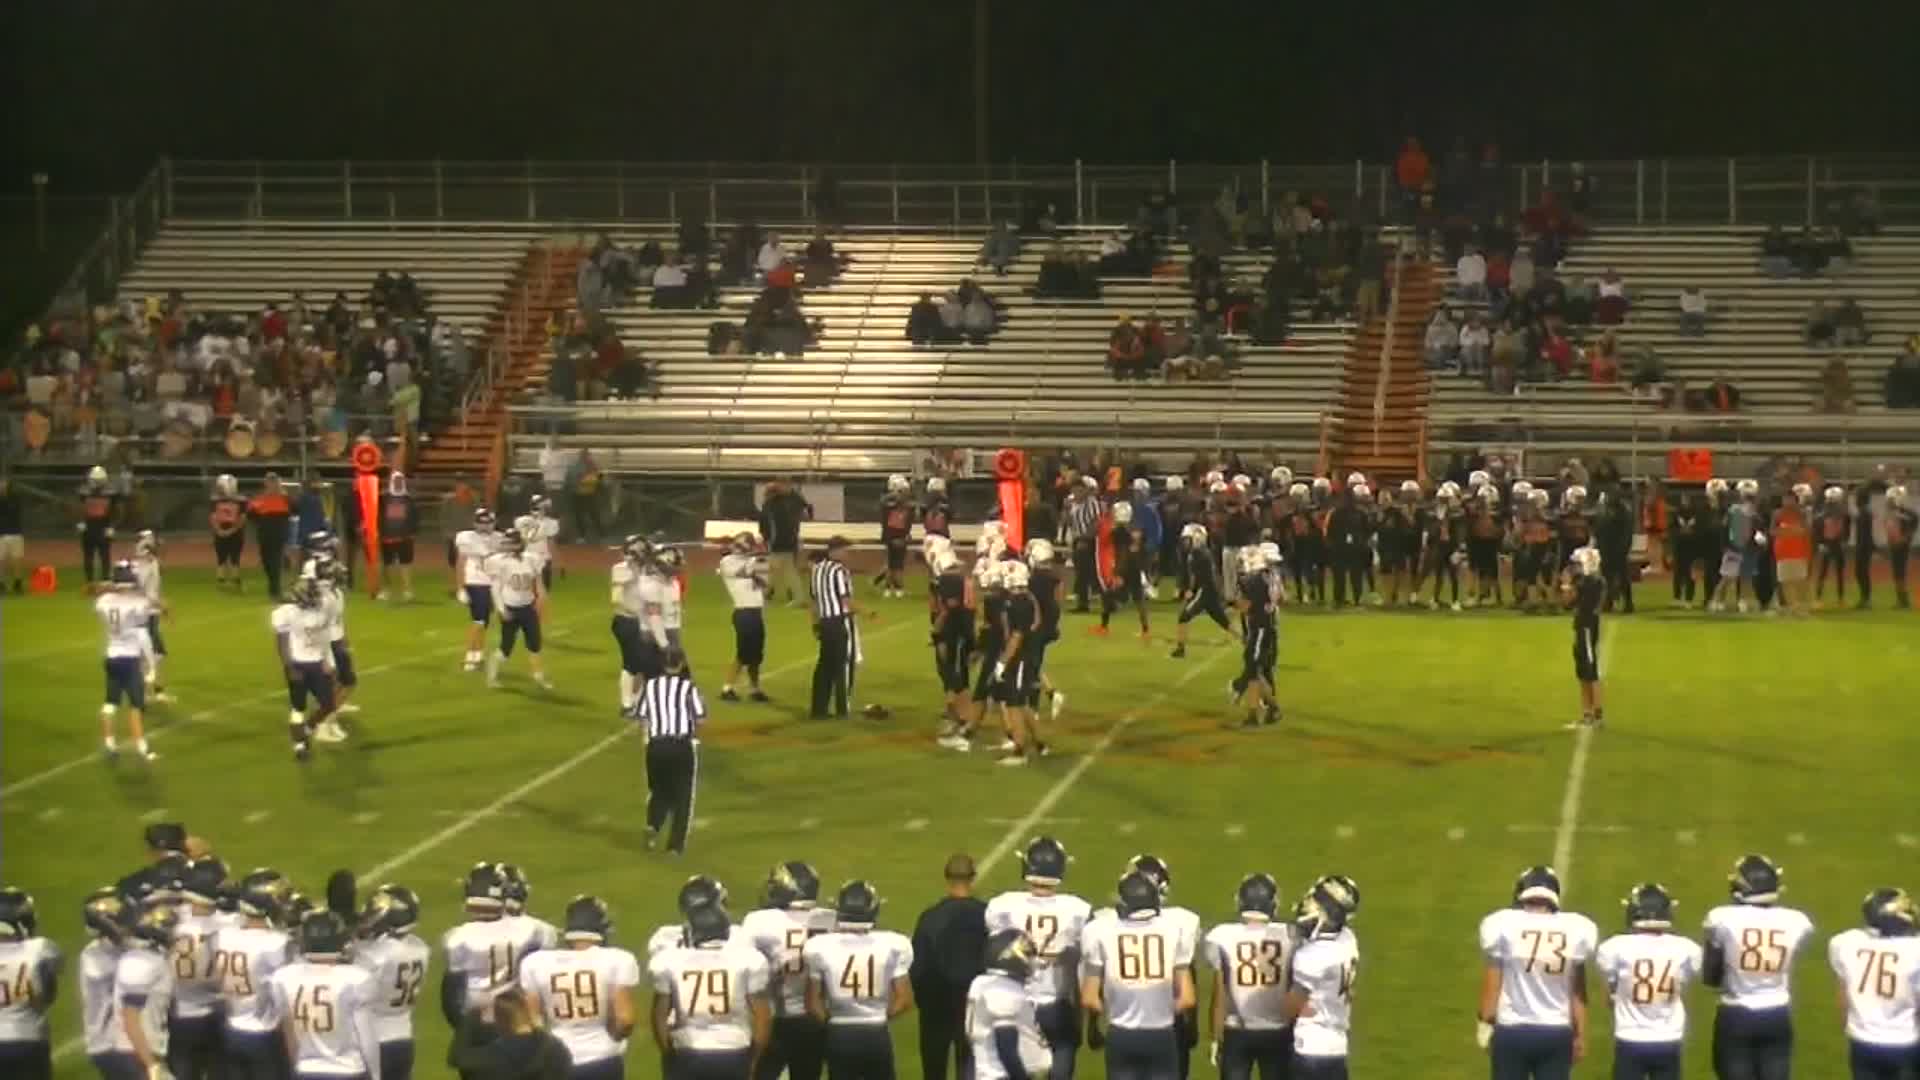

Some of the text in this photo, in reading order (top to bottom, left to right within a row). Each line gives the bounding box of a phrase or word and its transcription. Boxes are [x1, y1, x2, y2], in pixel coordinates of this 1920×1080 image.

[1118, 934, 1165, 980] 60
[1236, 940, 1282, 986] 83
[1521, 930, 1567, 974] 73
[1740, 928, 1787, 973] 85
[1856, 948, 1899, 999] 76
[550, 970, 599, 1018] 59
[682, 969, 729, 1017] 79
[840, 953, 875, 999] 41
[1632, 959, 1675, 1004] 84
[294, 984, 334, 1031] 45
